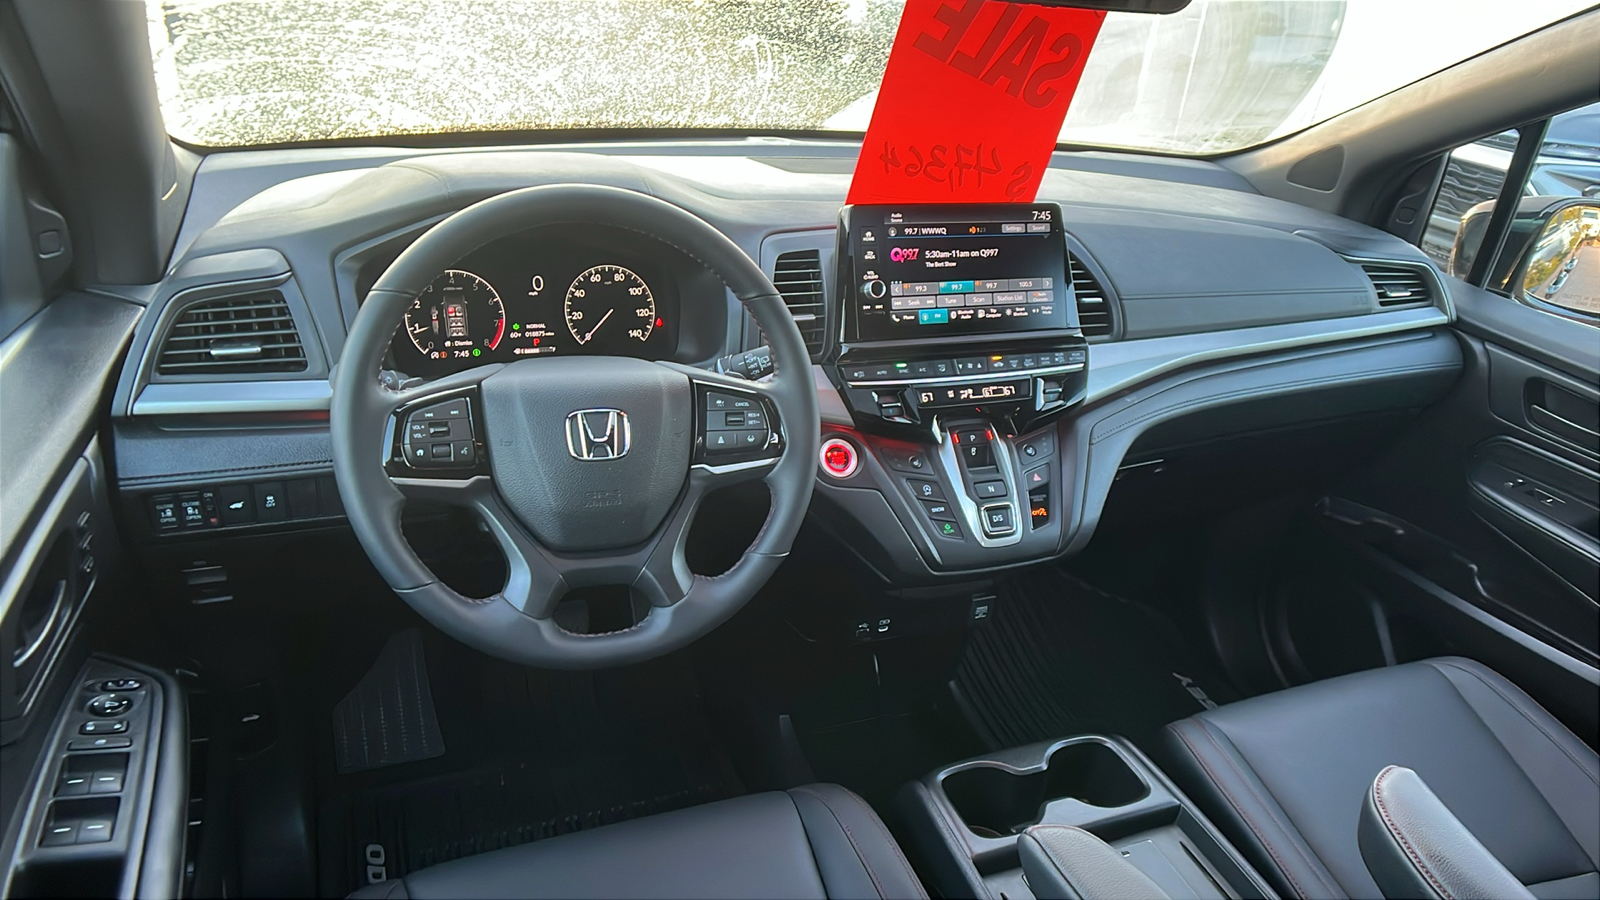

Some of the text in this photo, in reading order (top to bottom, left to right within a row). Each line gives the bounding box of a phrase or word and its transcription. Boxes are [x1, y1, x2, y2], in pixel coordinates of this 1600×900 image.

[1032, 211, 1051, 220] 7:45
[921, 227, 947, 235] WWWQ
[925, 249, 969, 258] 5:30am-11am
[980, 249, 998, 258] Q997
[590, 274, 601, 283] 60
[614, 274, 625, 282] 80
[532, 275, 544, 291] 0
[428, 285, 433, 293] 3
[628, 287, 642, 295] 100
[574, 290, 585, 298] 40
[414, 301, 420, 309] 2
[572, 312, 583, 320] 20
[636, 309, 649, 317] 120
[414, 323, 419, 331] 1
[628, 330, 642, 338] 140
[428, 341, 434, 349] 0
[533, 338, 540, 346] P
[454, 350, 470, 358] 7:45
